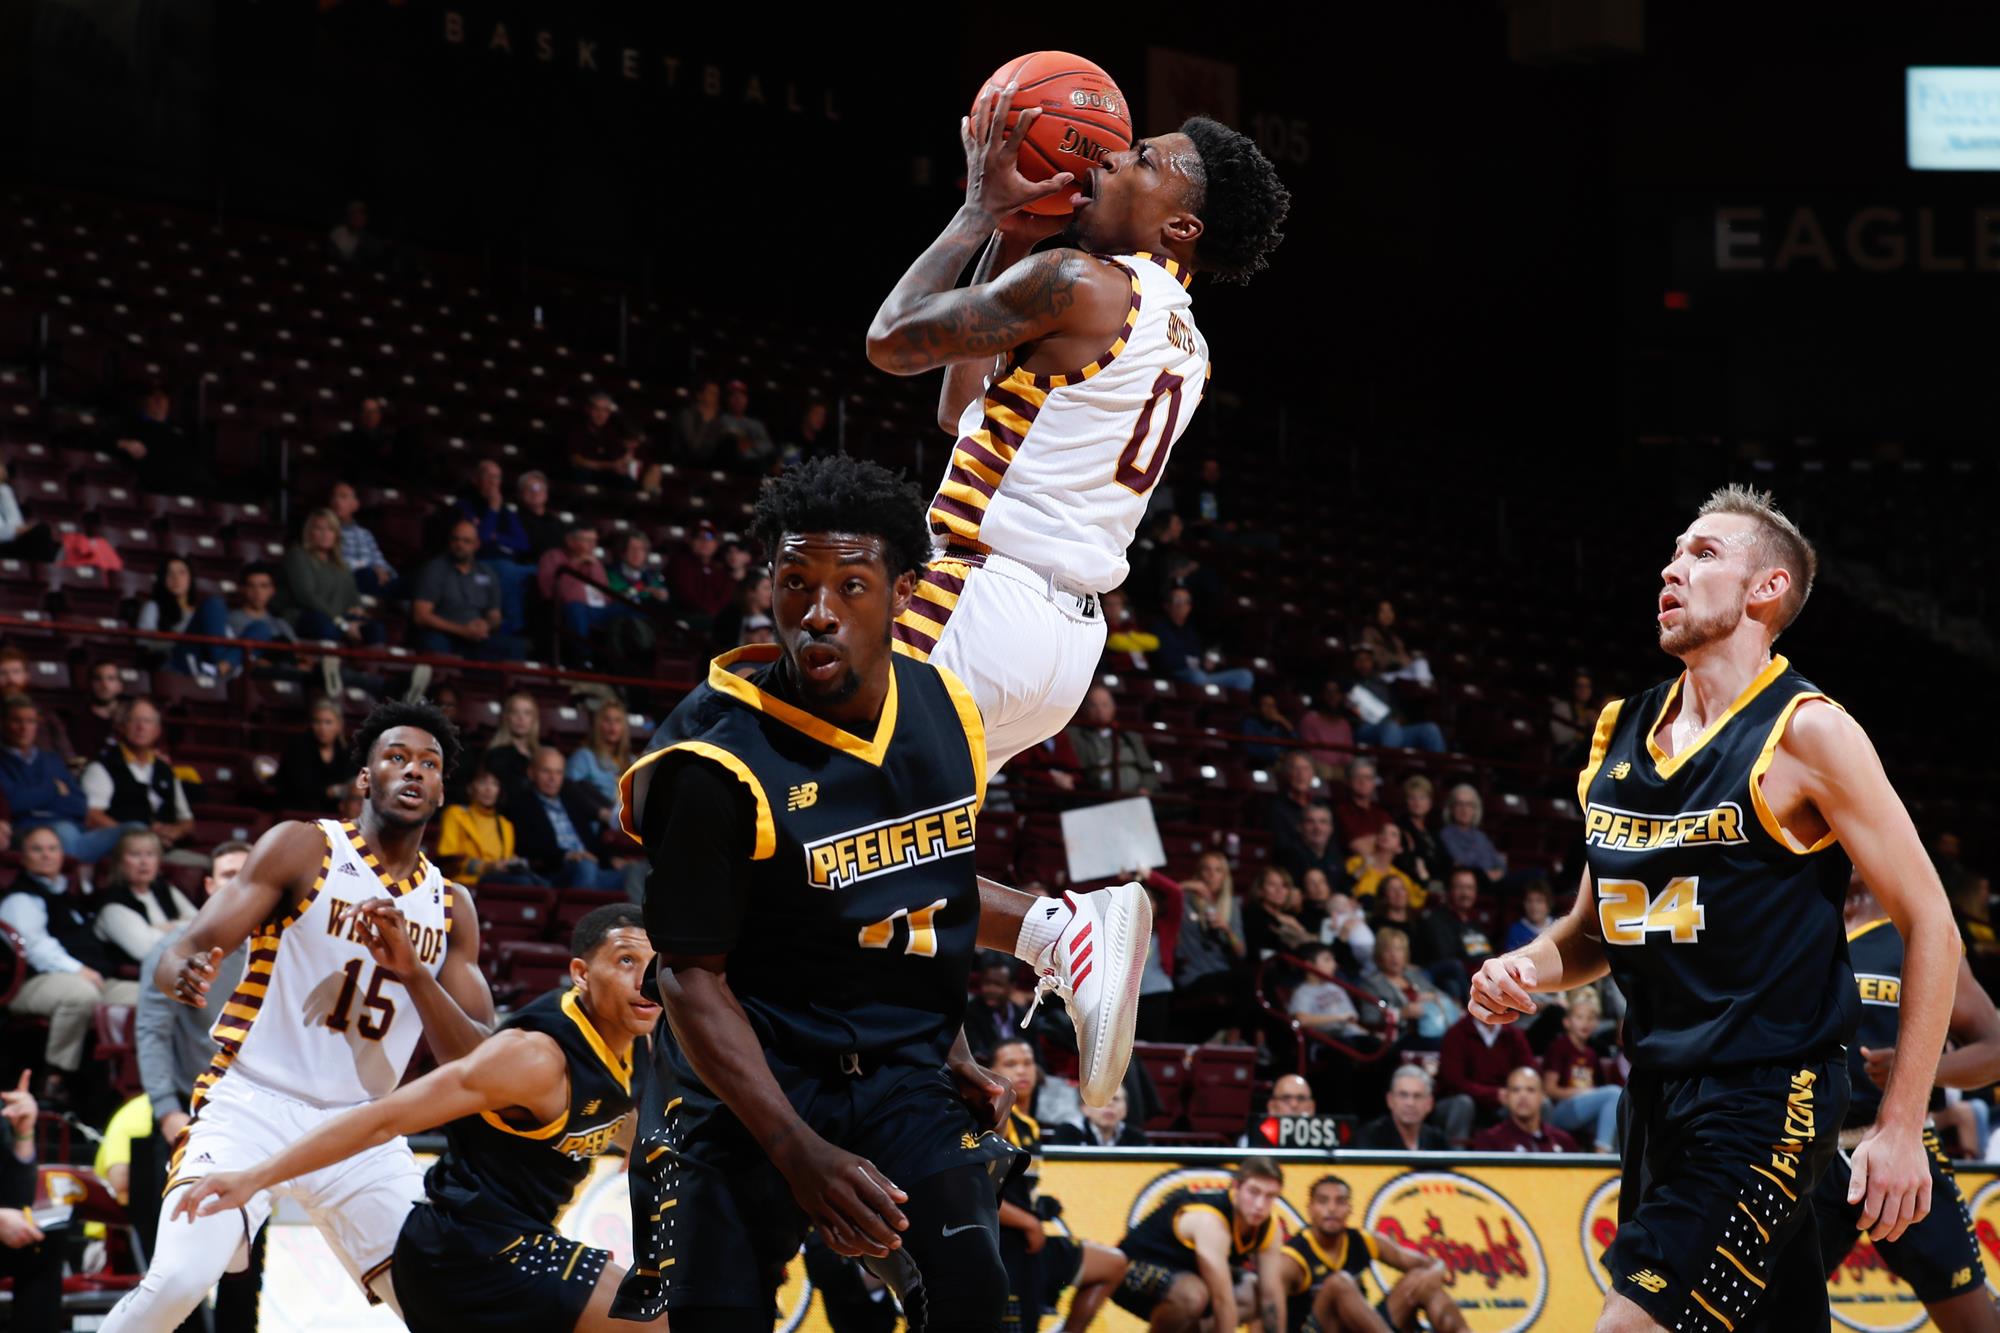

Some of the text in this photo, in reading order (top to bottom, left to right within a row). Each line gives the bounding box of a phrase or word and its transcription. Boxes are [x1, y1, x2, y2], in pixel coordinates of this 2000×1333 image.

[443, 8, 844, 124] BASKETBALL
[1113, 367, 1184, 496] 0
[1586, 807, 1739, 848] PFEIFFER
[1598, 876, 1706, 945] 24
[326, 957, 396, 1042] 15
[1855, 978, 1899, 1003] ER
